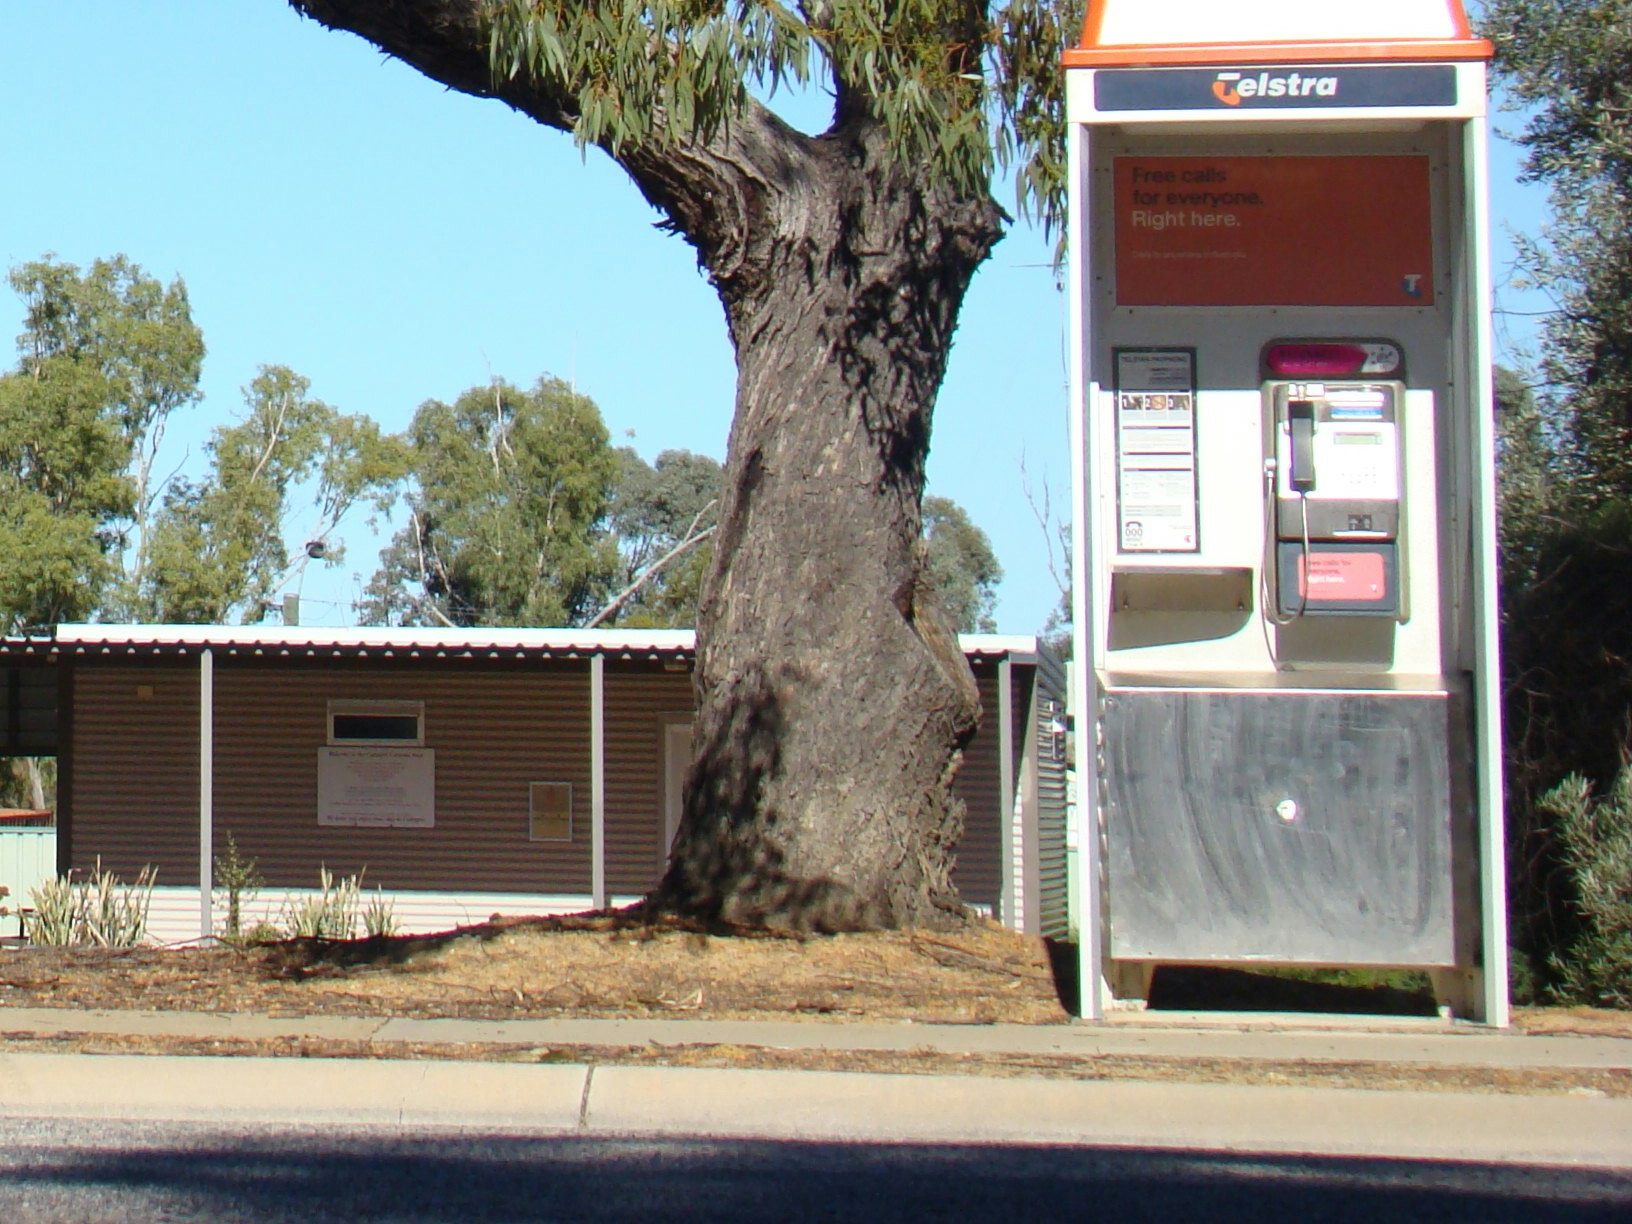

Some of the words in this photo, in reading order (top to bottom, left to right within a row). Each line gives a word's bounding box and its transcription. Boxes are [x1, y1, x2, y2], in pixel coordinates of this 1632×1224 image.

[1212, 72, 1338, 106] Telstra
[1132, 167, 1177, 184] Free
[1182, 167, 1227, 184] calls
[1133, 189, 1160, 206] for
[1167, 191, 1265, 208] everyone.
[1131, 210, 1186, 231] Right
[1191, 210, 1241, 227] here.
